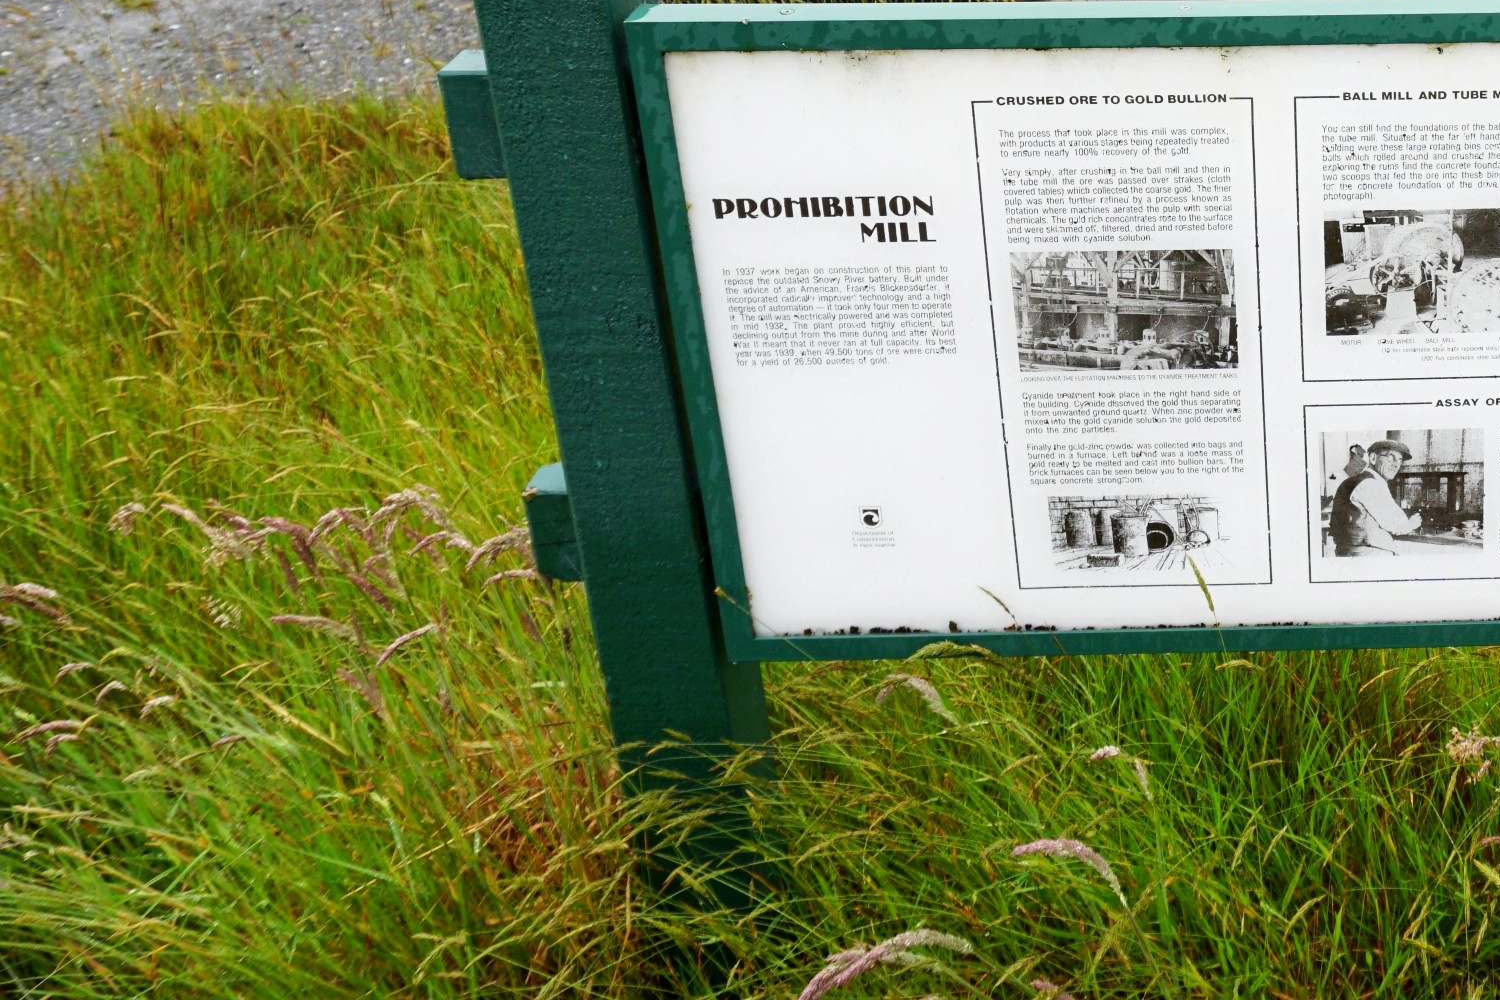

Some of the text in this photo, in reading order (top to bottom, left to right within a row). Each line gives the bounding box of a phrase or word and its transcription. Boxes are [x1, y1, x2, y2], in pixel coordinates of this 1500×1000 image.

[996, 93, 1227, 106] CRUSHED ORE TO GOLD BULLION
[1342, 91, 1377, 101] BALL
[1381, 91, 1413, 101] MILL
[1418, 90, 1448, 100] AND
[1452, 90, 1488, 100] TUBE
[711, 195, 934, 220] PROHIBITION
[860, 221, 937, 243] MILL
[1435, 398, 1479, 408] ASSAY
